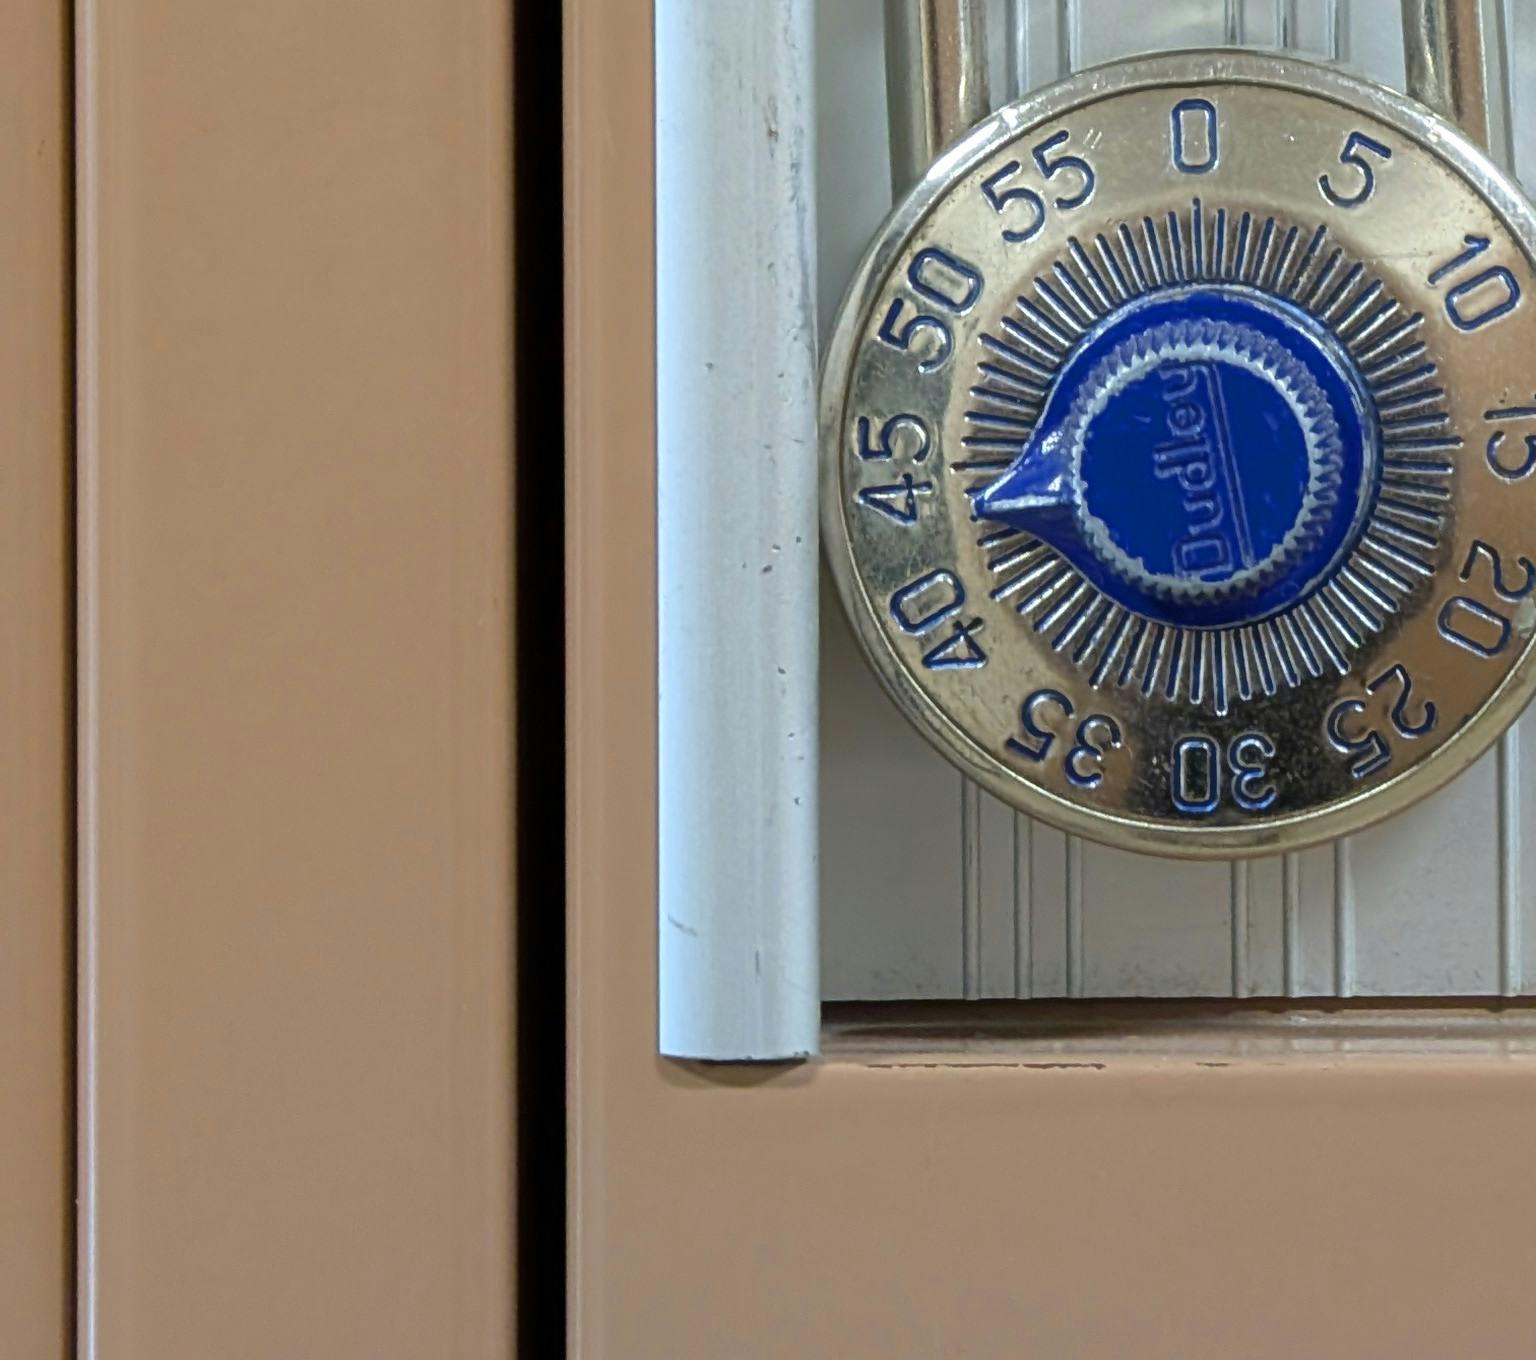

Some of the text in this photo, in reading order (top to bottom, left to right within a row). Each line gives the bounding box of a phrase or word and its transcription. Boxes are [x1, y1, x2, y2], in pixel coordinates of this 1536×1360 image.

[981, 130, 1096, 243] 55
[1171, 98, 1219, 174] 0
[1318, 131, 1392, 209] 5
[879, 247, 985, 373] 50
[1428, 233, 1522, 332] 10
[858, 412, 935, 524] 45
[1154, 360, 1235, 578] Dudley
[889, 567, 987, 671] 40
[1006, 688, 1121, 788] 35
[1171, 733, 1276, 813] 30
[1326, 664, 1436, 779] 25
